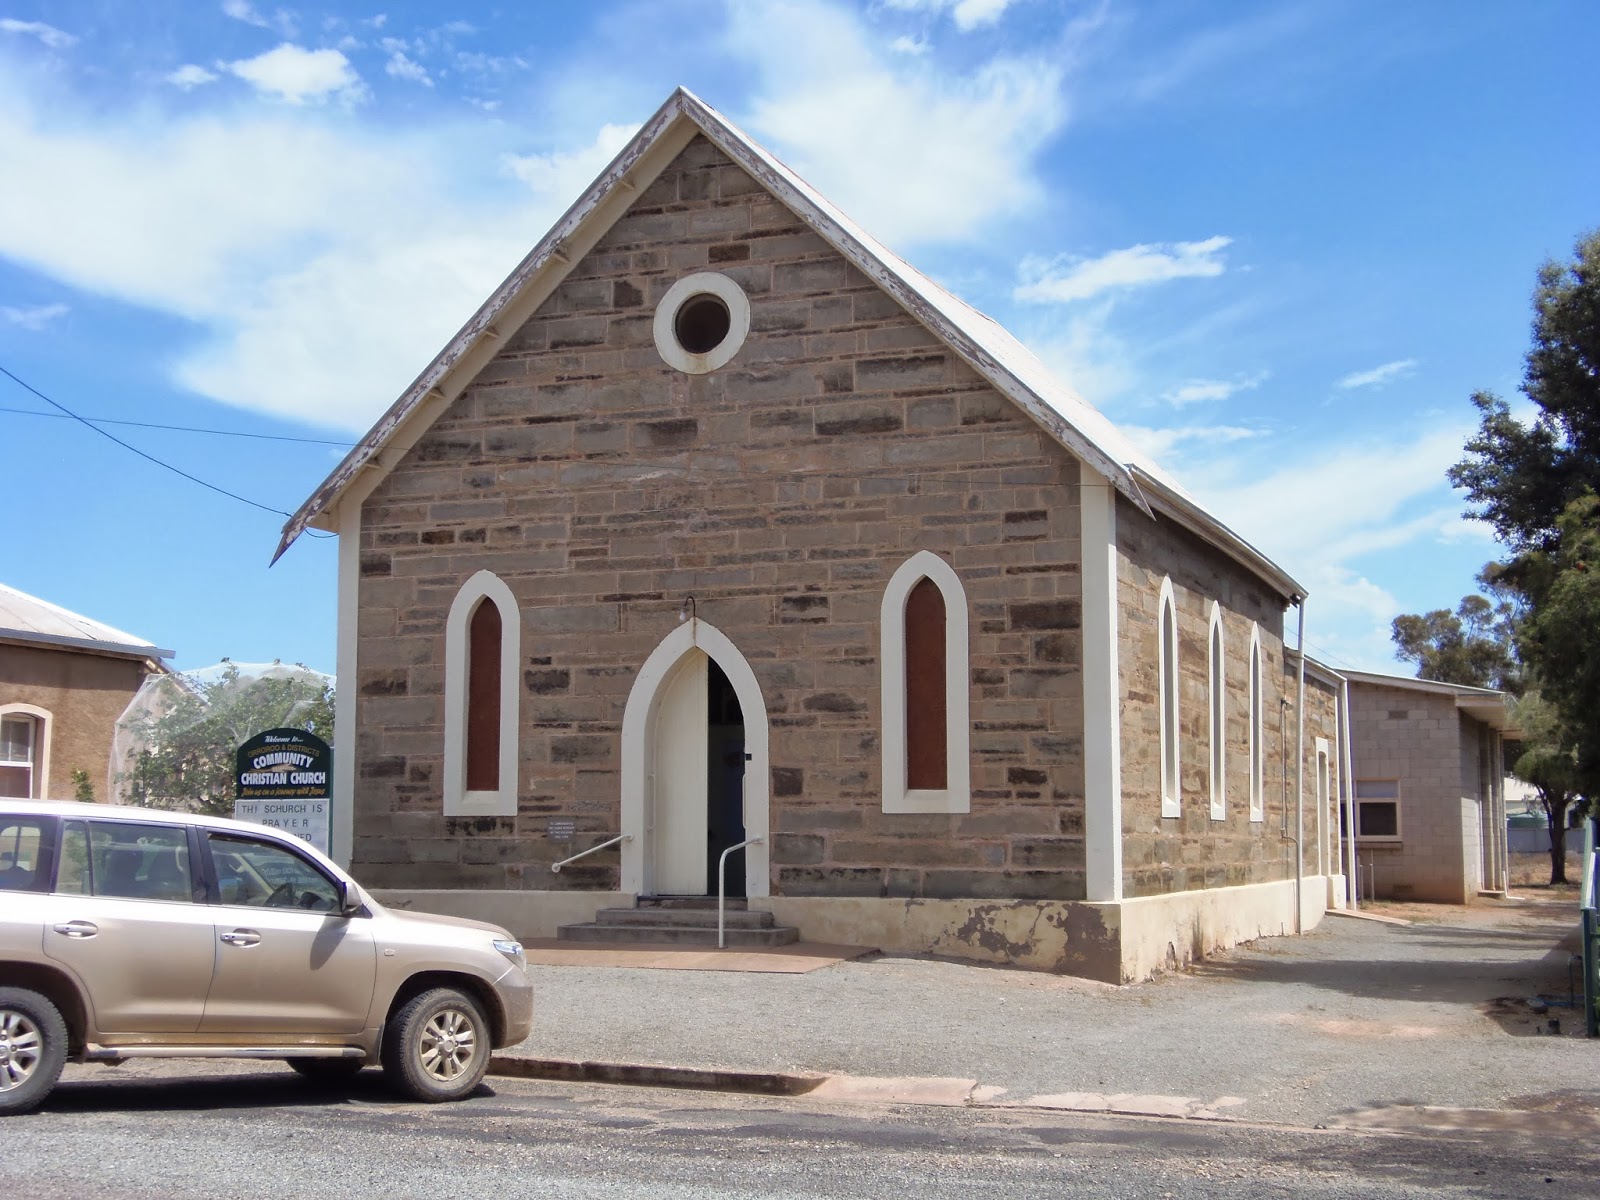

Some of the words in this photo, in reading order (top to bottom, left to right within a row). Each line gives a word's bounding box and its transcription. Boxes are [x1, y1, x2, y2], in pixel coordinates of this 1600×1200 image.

[265, 735, 290, 743] Welcome
[247, 744, 281, 758] ORROROO
[287, 744, 320, 757] DISTRICTS
[253, 752, 314, 769] COMMUNITY
[241, 772, 287, 785] CHRISTIAN
[290, 772, 326, 785] CHURCH
[264, 804, 306, 813] SCHURCH
[312, 804, 323, 813] IS
[262, 819, 309, 828] PRAYER
